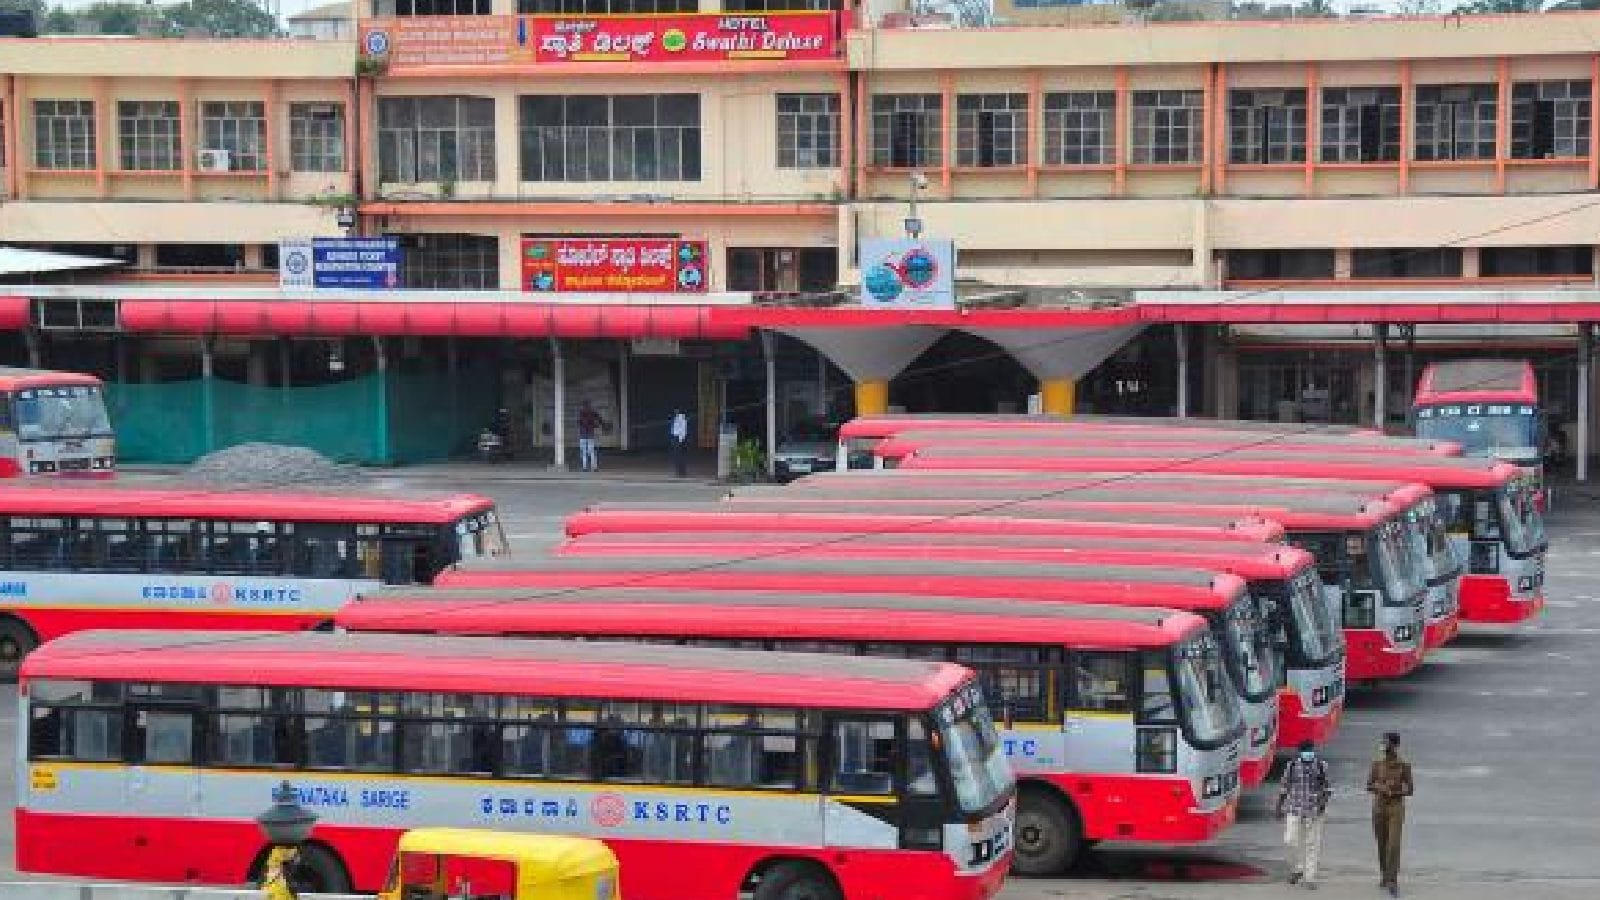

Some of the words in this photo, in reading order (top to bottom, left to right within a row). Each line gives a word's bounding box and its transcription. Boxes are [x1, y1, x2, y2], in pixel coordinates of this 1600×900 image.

[718, 17, 767, 30] HOTEL
[235, 588, 301, 602] KSRTC
[361, 789, 410, 809] SARIGE
[633, 800, 732, 826] KSRTC
